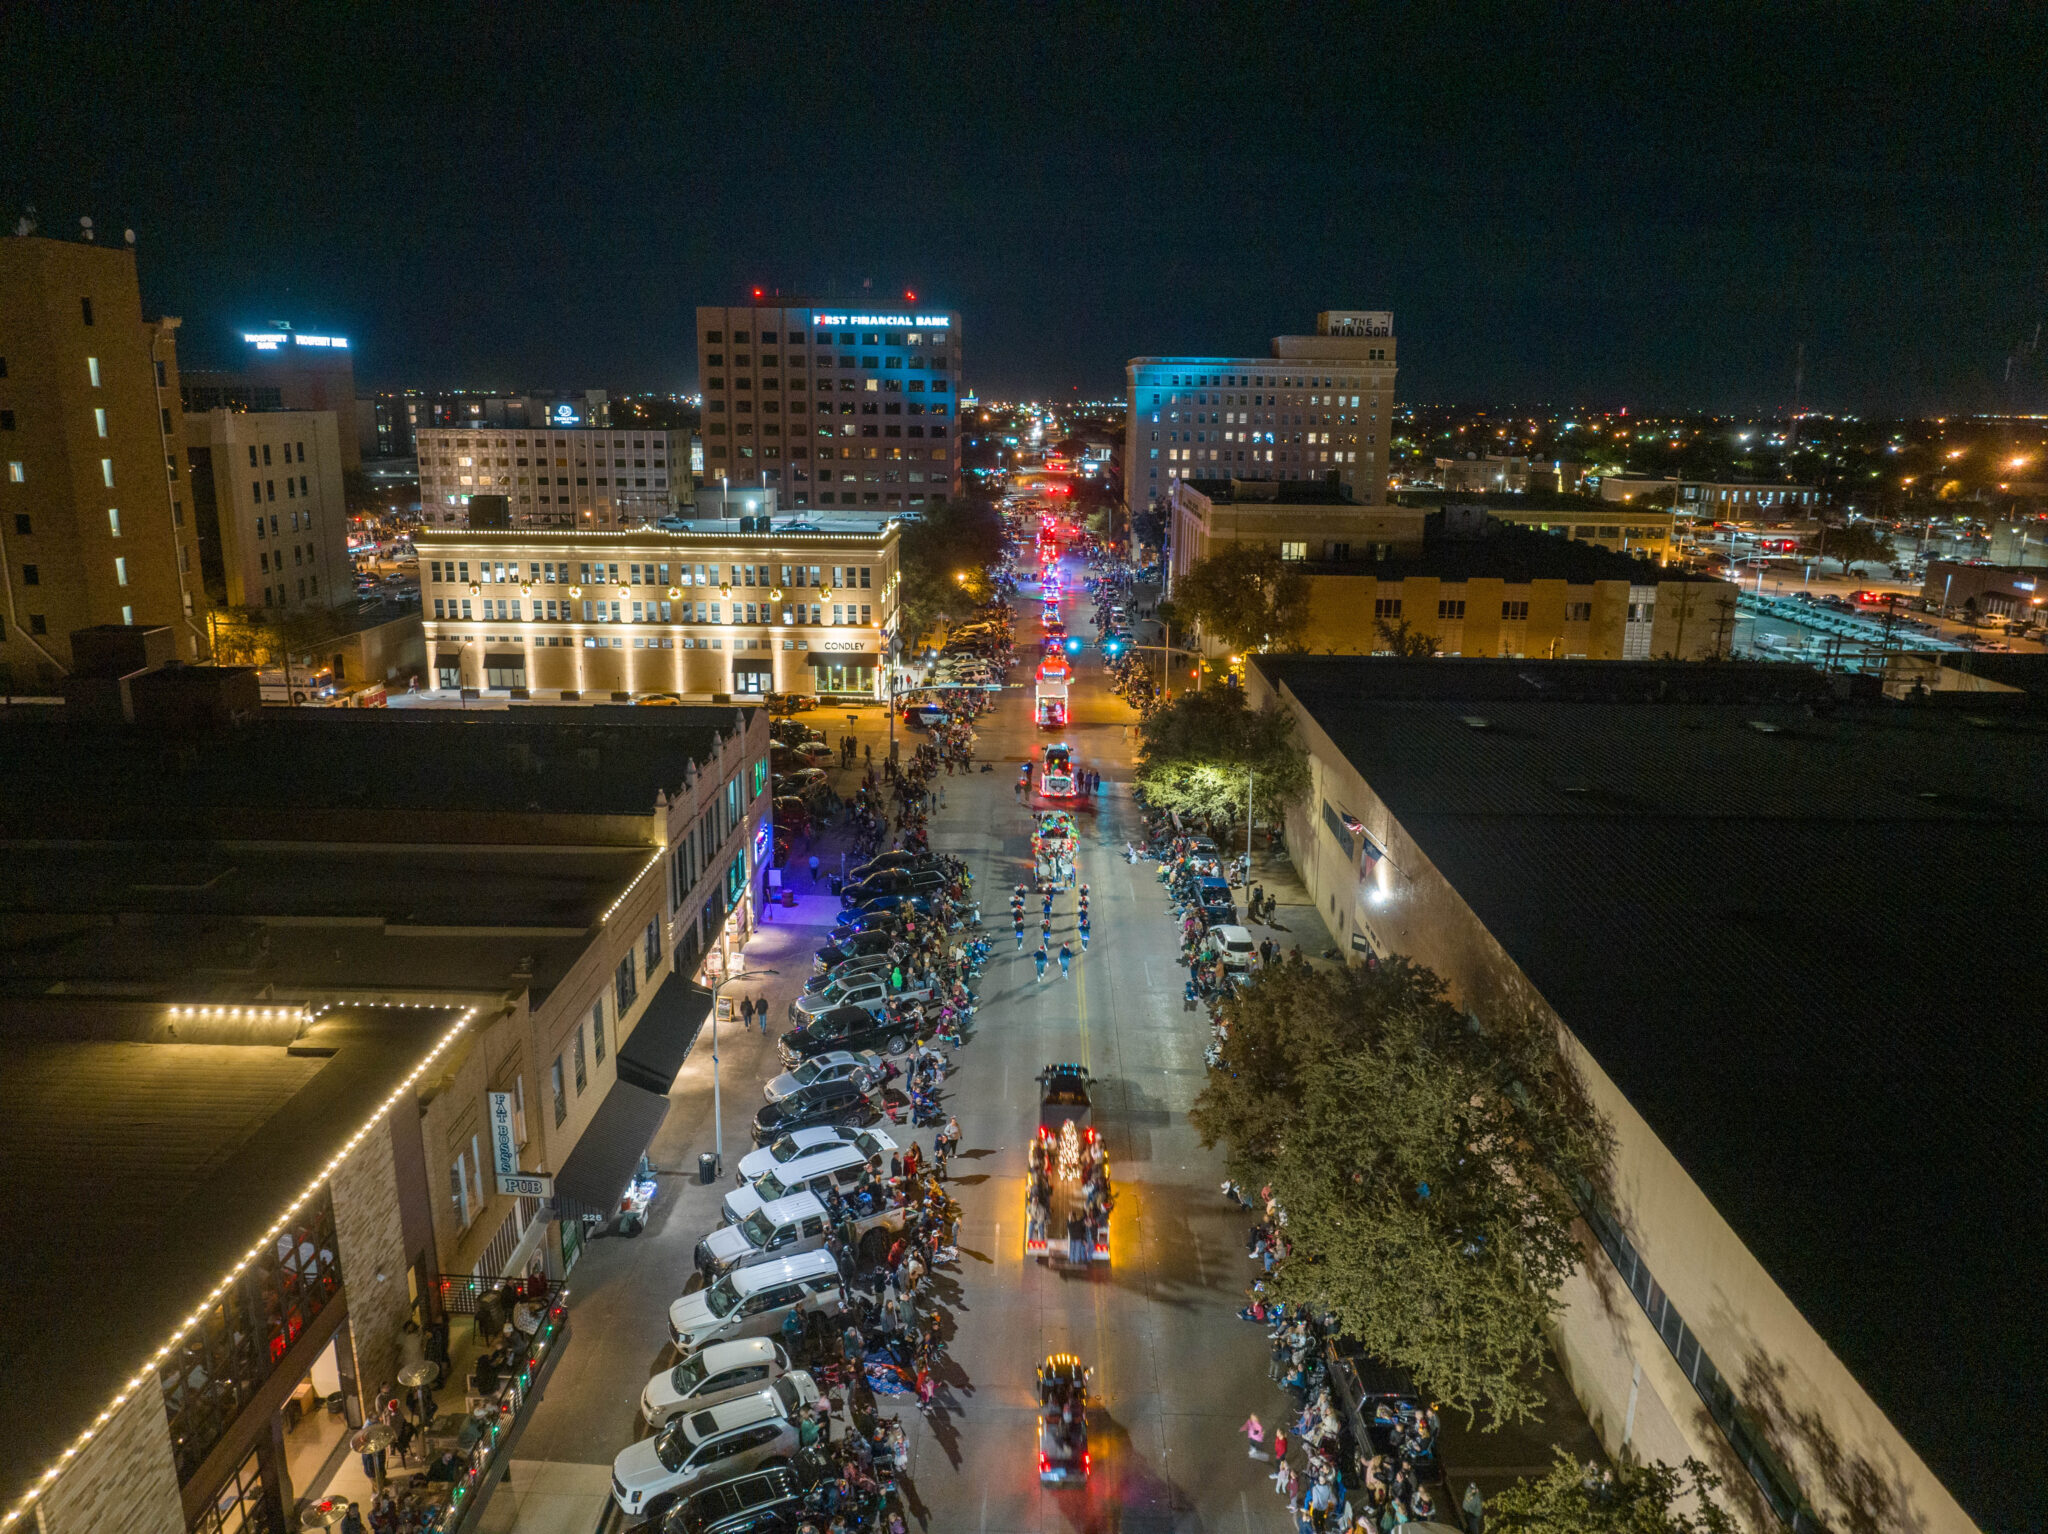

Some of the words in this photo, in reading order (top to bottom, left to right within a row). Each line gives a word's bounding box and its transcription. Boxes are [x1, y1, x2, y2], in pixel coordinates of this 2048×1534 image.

[813, 314, 848, 326] FIRST
[850, 315, 913, 326] FINANCIAL
[916, 316, 949, 326] BANK
[1331, 326, 1389, 337] WINDSOR
[824, 642, 865, 651] CONDLEY
[495, 1094, 508, 1123] FAT
[505, 1178, 543, 1194] PUB
[581, 1214, 603, 1222] 226
